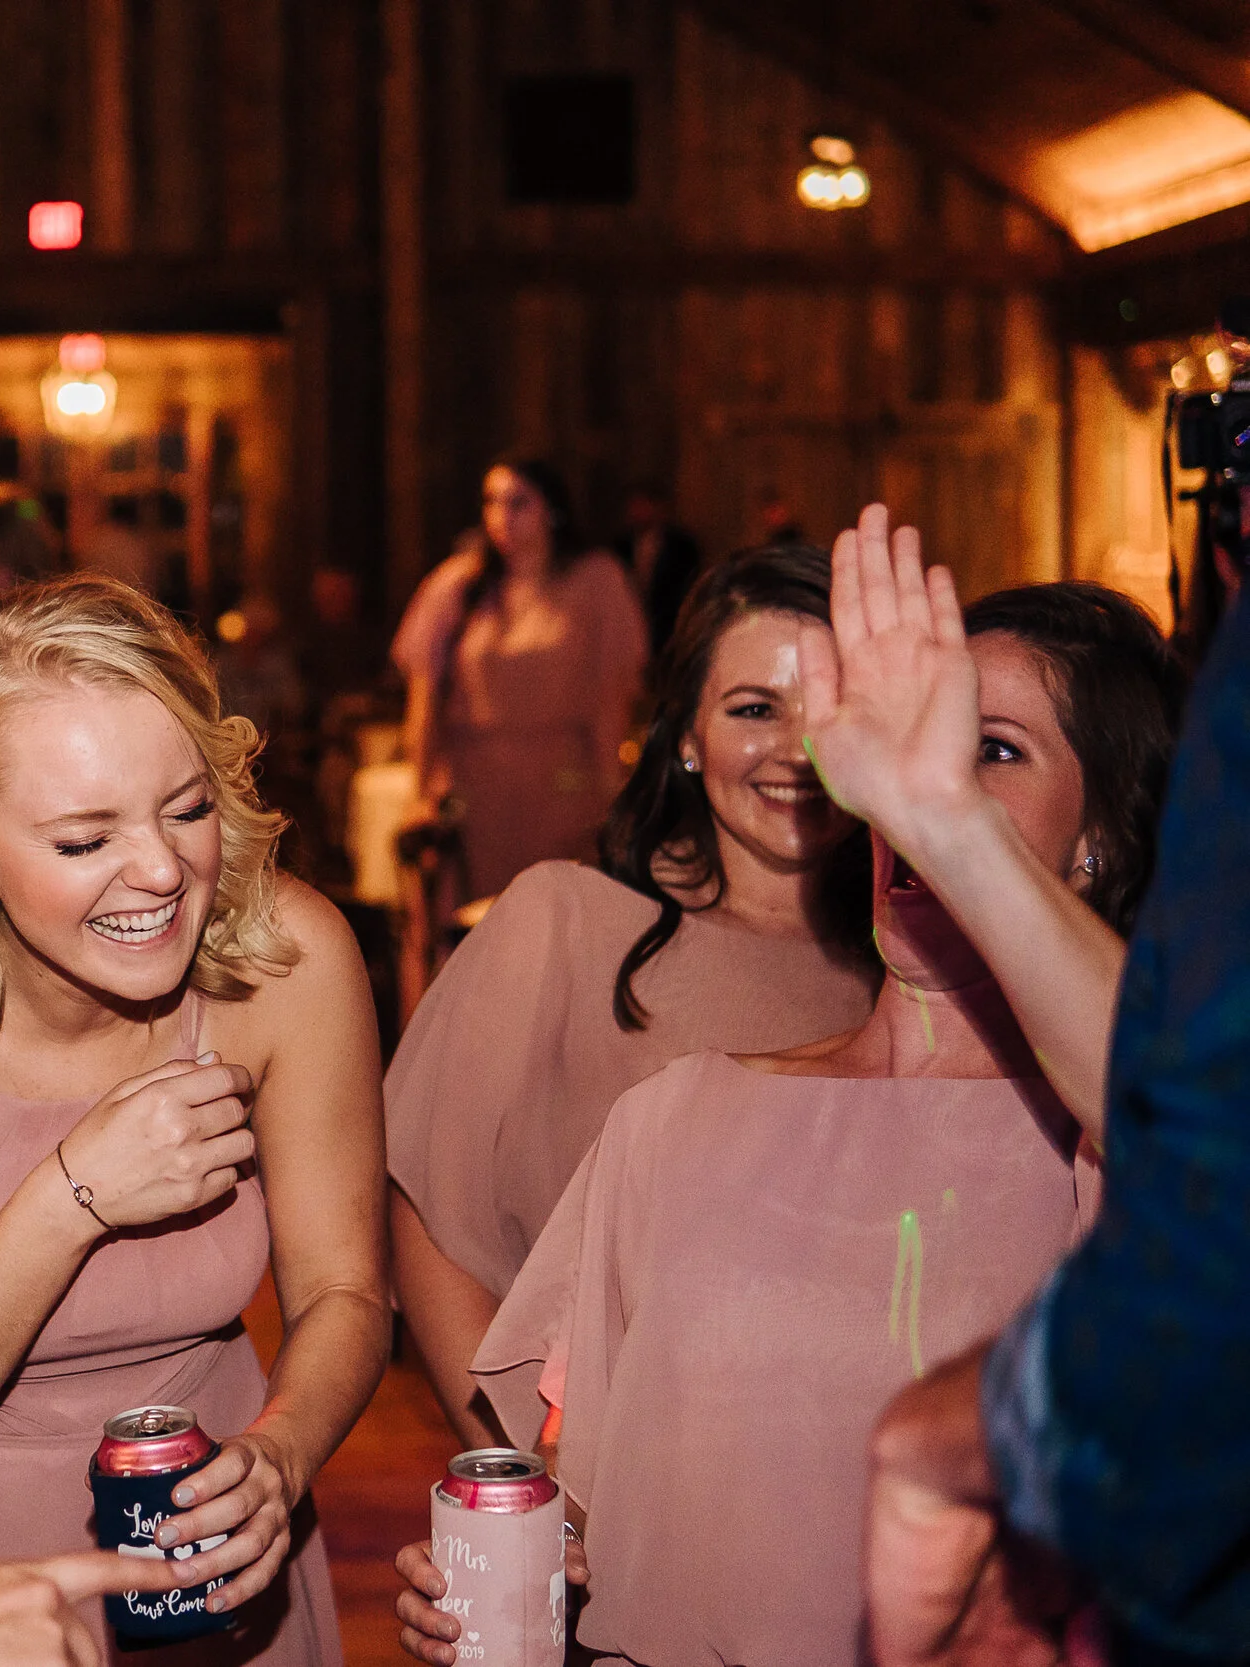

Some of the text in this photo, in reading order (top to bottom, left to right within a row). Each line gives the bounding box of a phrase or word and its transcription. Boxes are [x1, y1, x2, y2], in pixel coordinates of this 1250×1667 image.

[442, 1535, 492, 1572] Mrs.
[123, 1588, 205, 1620] Cows Come
[458, 1645, 485, 1659] 2019
